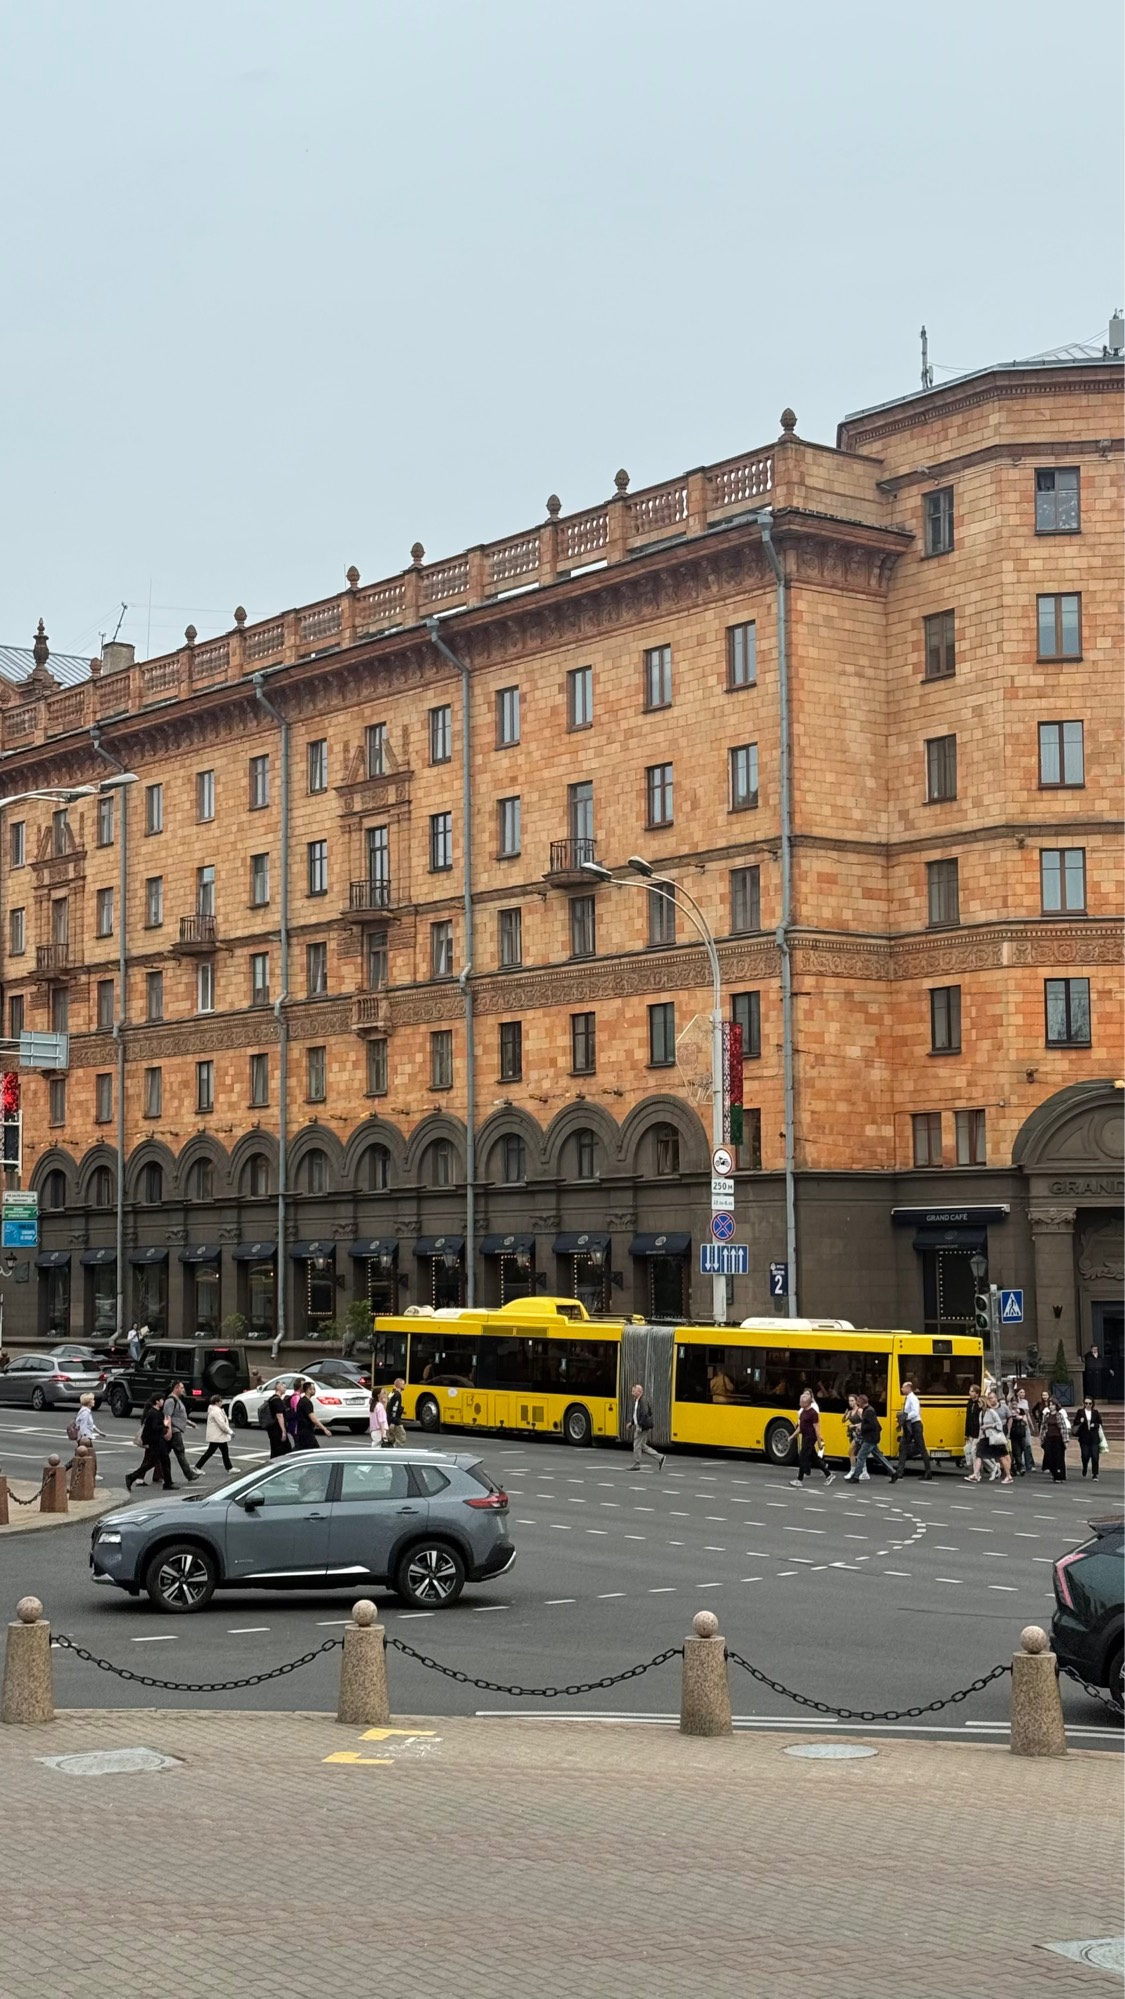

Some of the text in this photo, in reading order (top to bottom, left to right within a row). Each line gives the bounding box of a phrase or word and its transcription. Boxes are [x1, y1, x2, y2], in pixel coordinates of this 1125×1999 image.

[713, 1182, 727, 1190] 250
[1049, 1181, 1124, 1195] GRAND
[774, 1275, 783, 1294] 2
